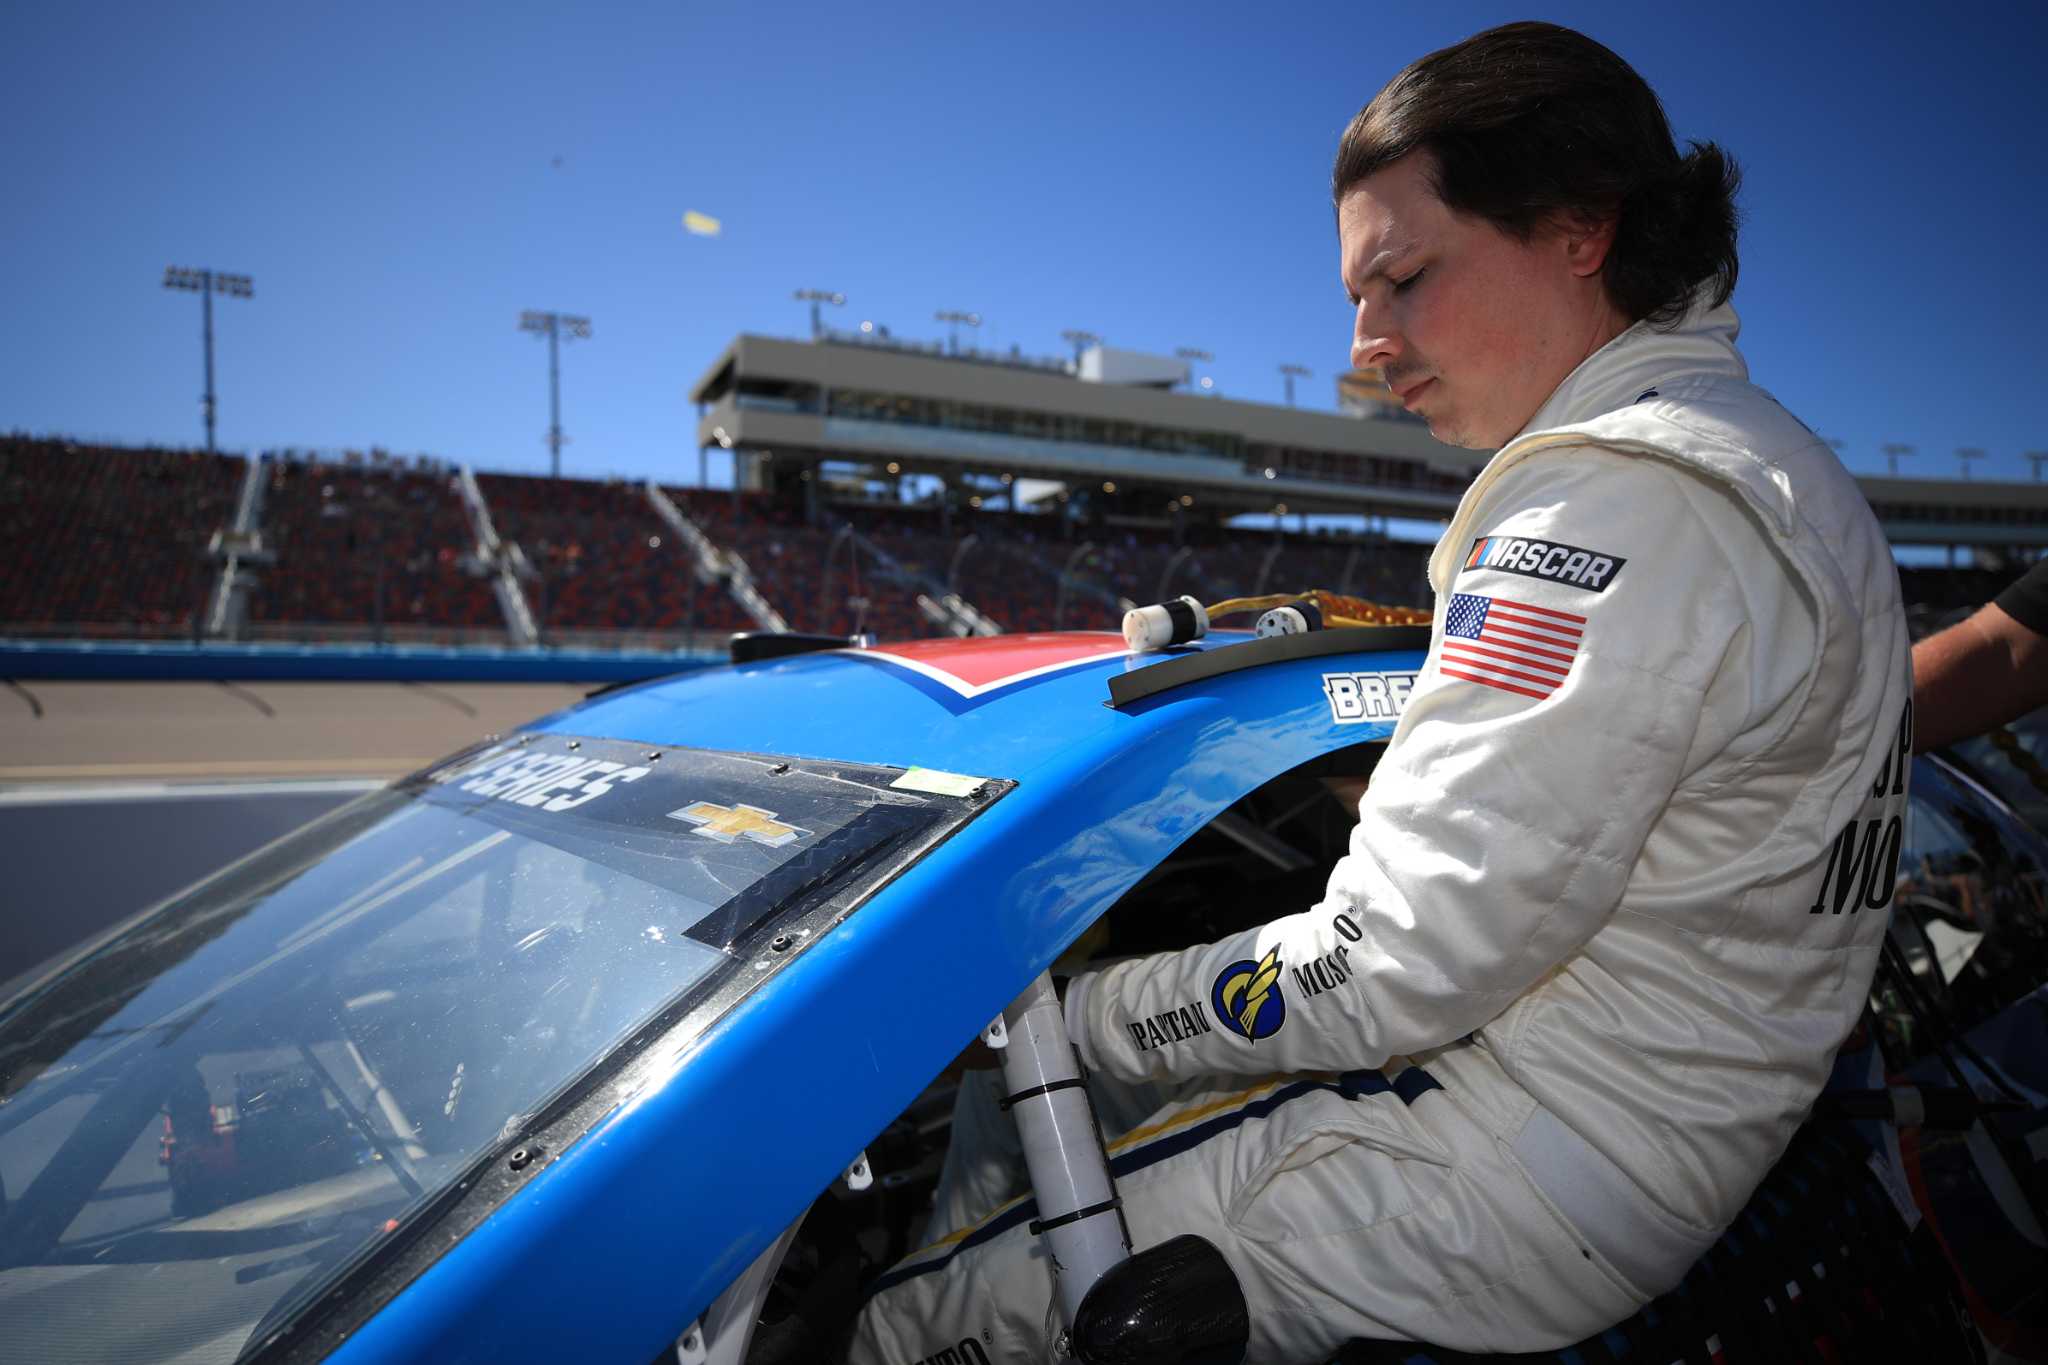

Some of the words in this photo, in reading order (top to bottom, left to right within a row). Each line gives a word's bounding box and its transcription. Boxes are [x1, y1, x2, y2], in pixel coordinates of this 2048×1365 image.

[1485, 538, 1613, 587] NASCAR
[460, 750, 652, 812] SERIES
[1809, 815, 1901, 914] MO
